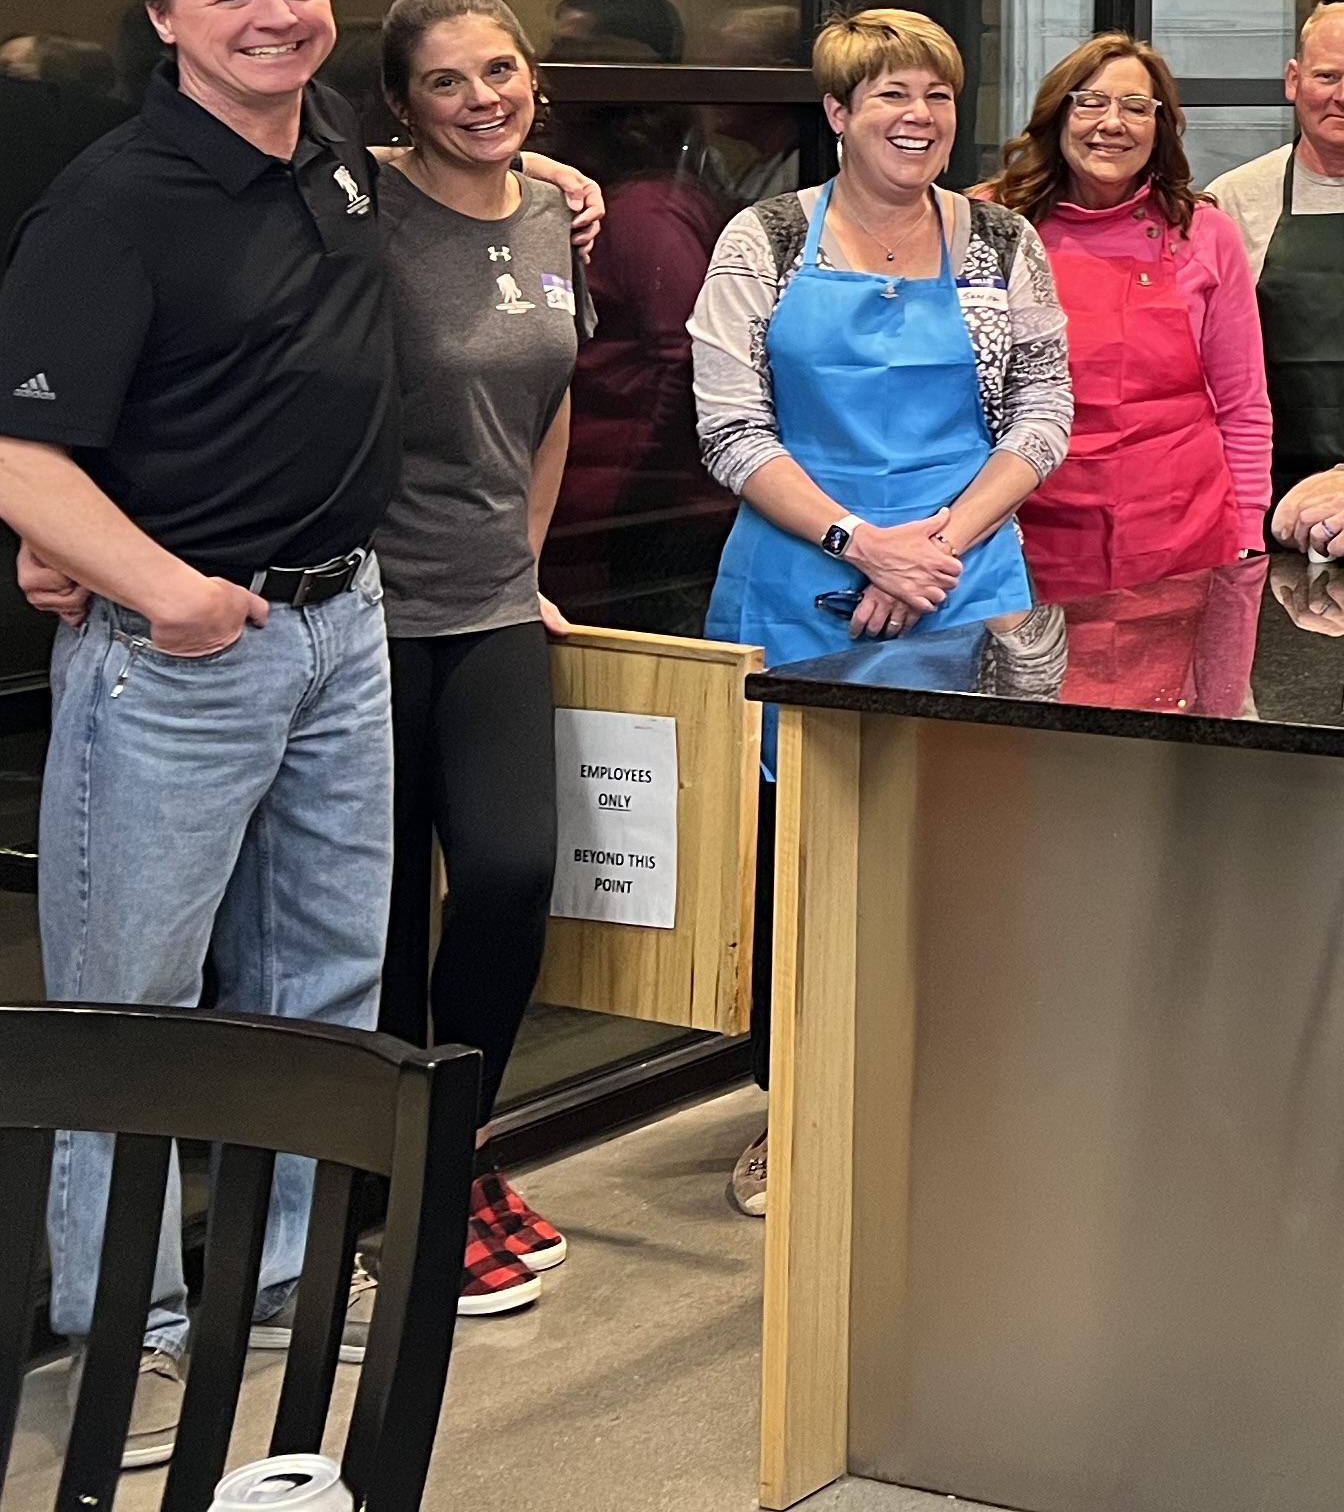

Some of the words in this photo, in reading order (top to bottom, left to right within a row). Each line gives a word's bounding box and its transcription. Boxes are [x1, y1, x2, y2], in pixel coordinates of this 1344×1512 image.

[13, 388, 56, 400] adidas
[580, 764, 653, 783] EMPLOYEES
[598, 793, 632, 809] ONLY
[573, 849, 625, 866] BEYOND
[628, 854, 656, 869] THIS
[594, 877, 634, 894] POINT
